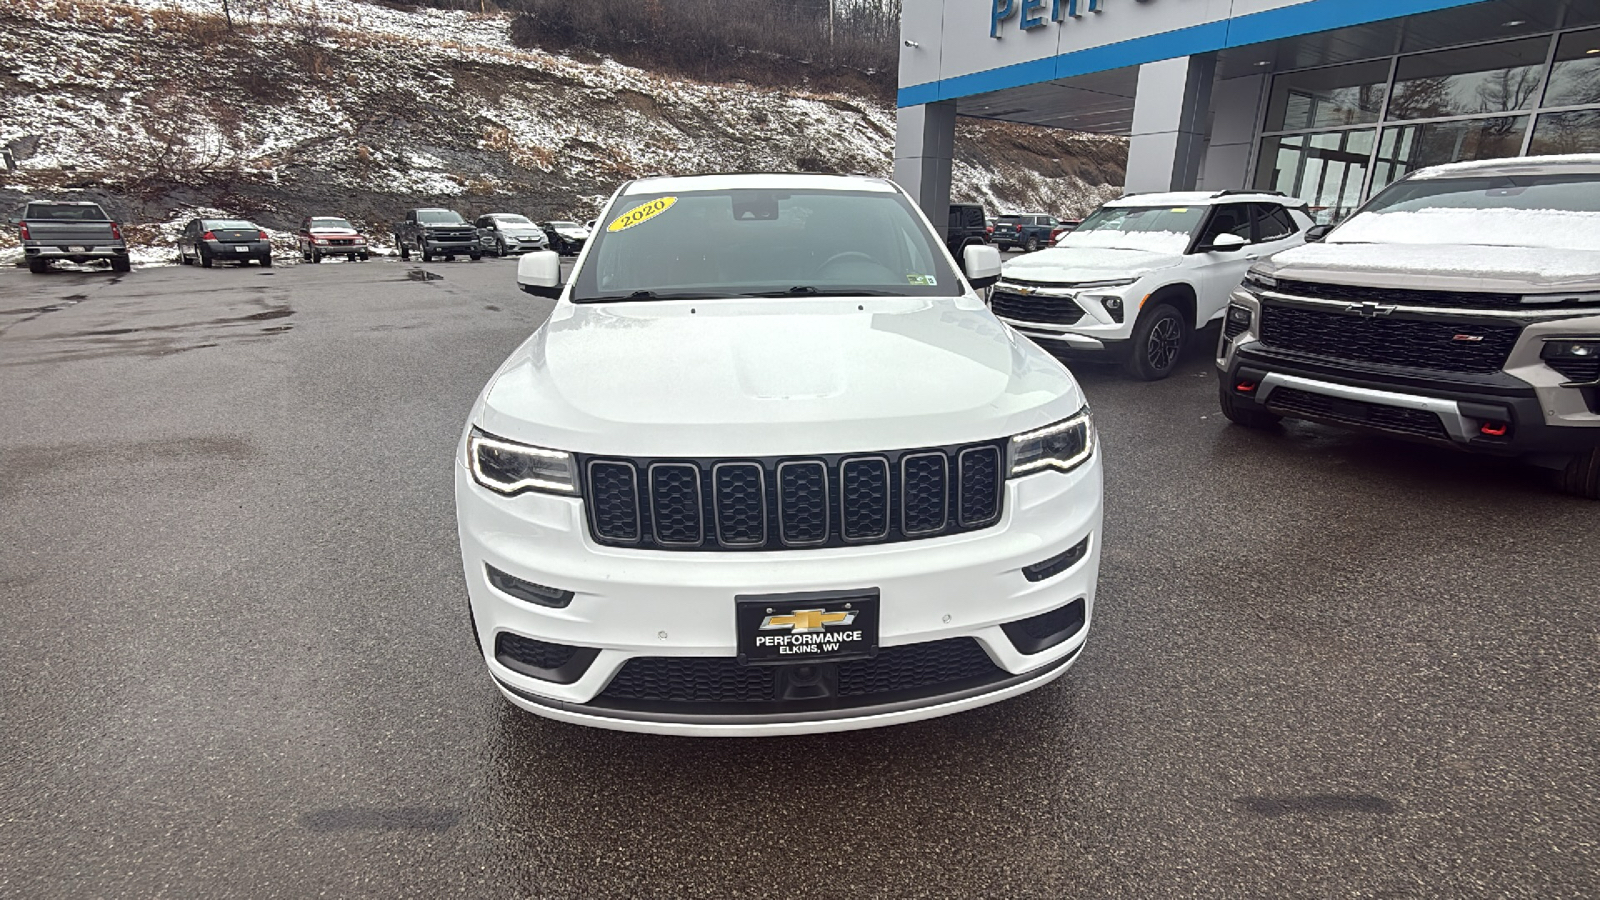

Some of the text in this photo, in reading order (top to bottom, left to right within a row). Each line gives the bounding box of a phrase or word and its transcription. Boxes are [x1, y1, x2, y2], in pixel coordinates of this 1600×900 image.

[620, 200, 665, 227] 2020
[756, 630, 862, 647] PERFORMANCE
[779, 642, 840, 654] ELKINS, WV
